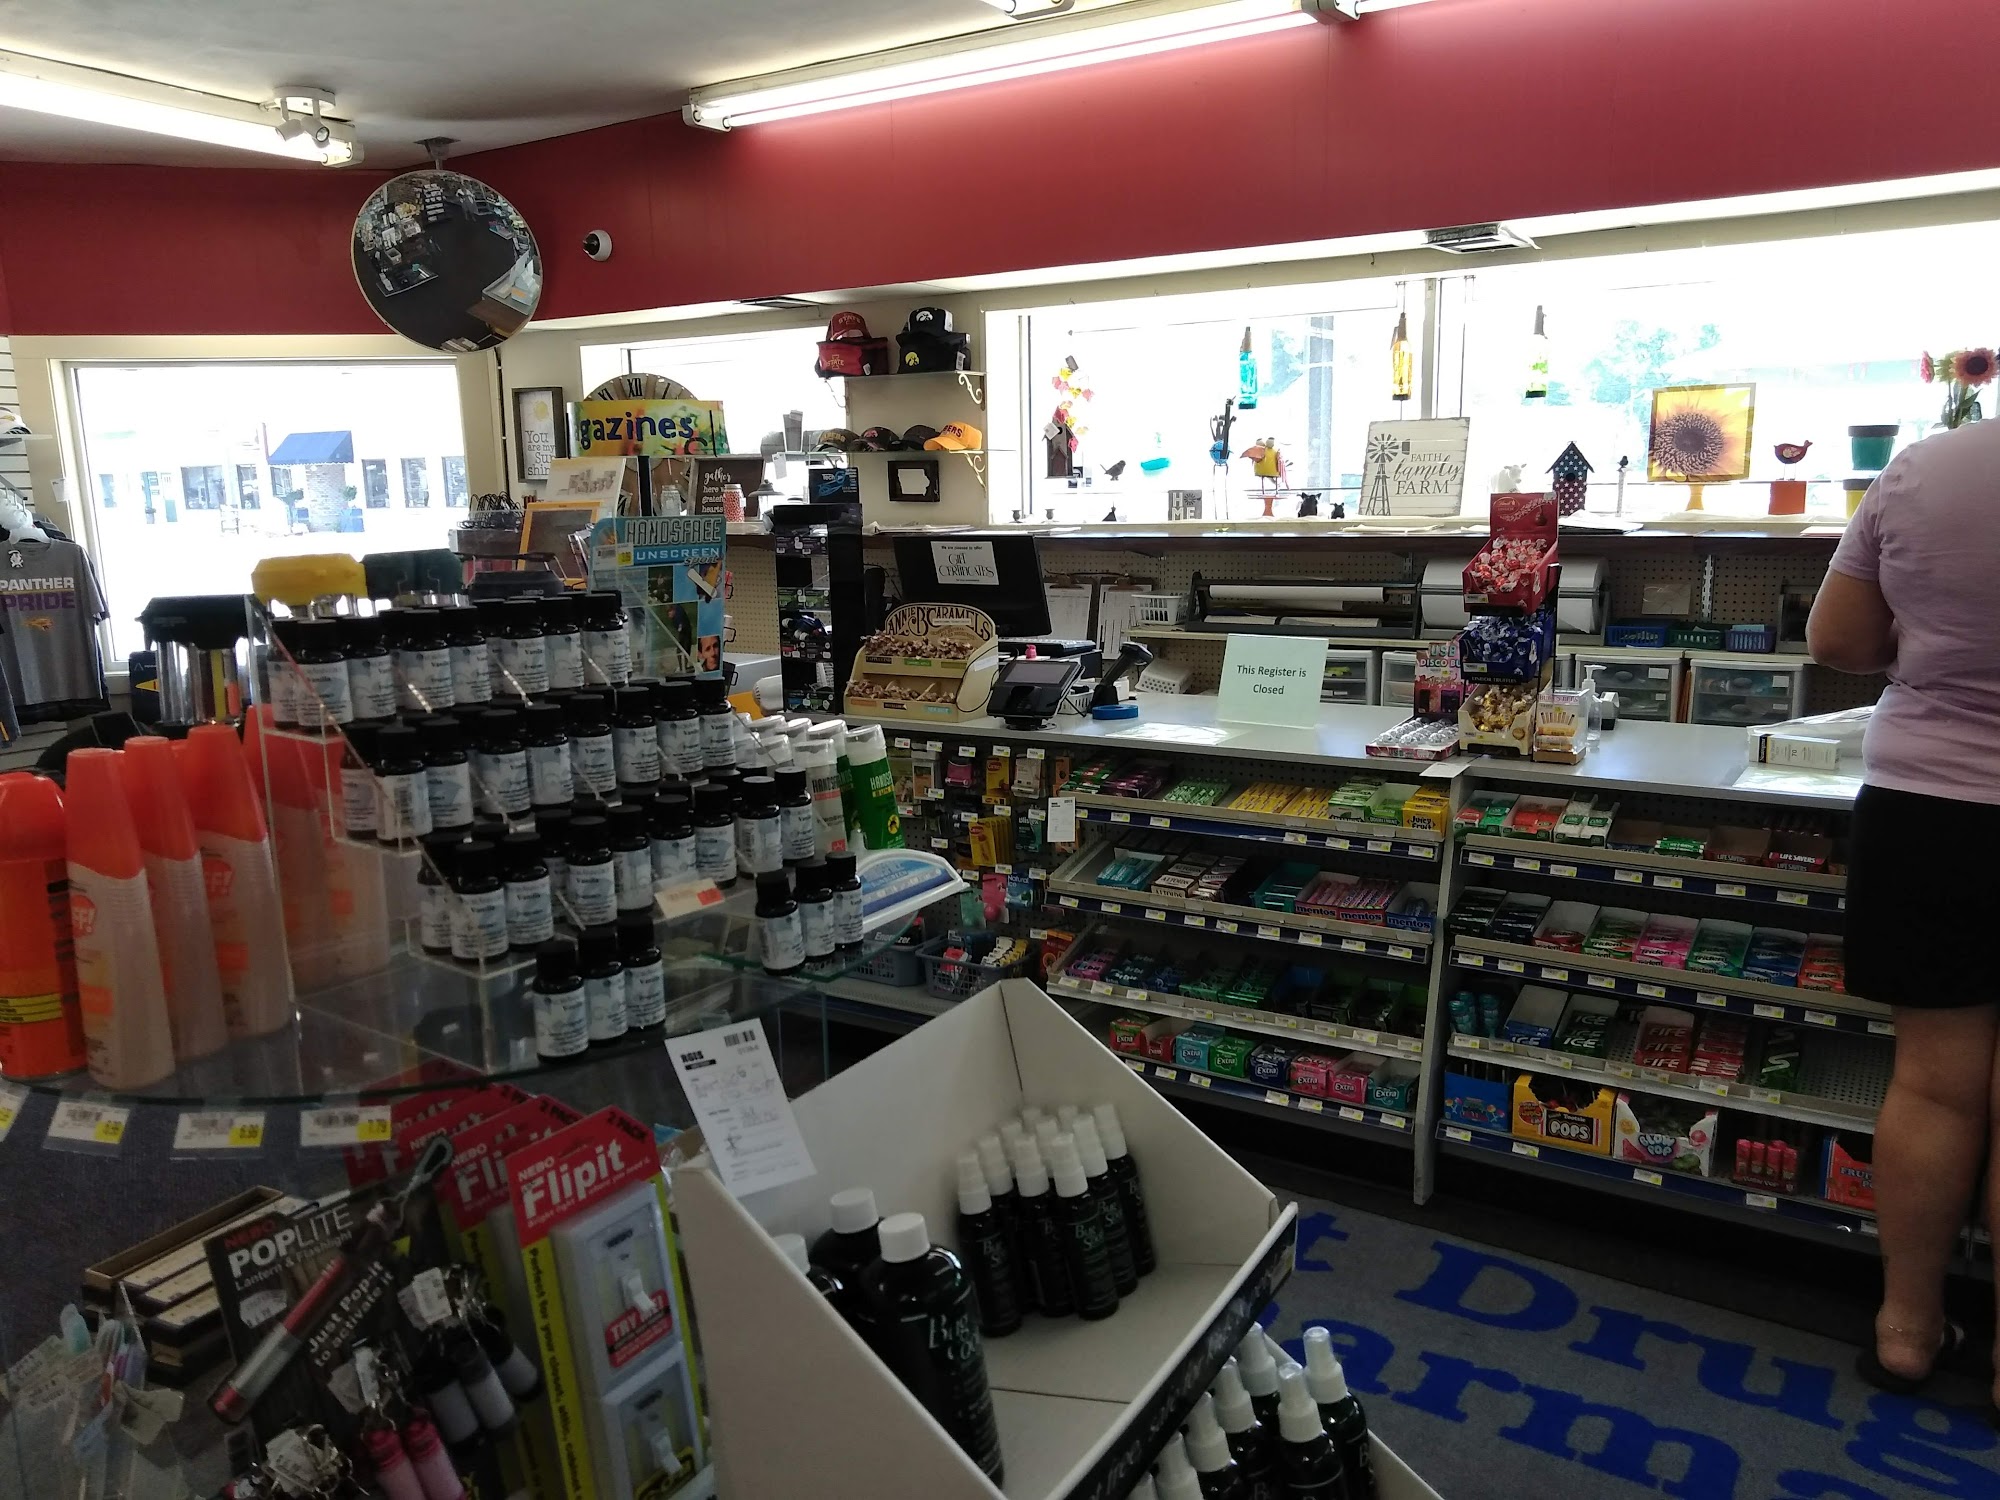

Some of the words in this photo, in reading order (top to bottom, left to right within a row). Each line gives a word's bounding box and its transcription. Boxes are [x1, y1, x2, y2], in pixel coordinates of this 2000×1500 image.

[525, 431, 549, 444] You
[541, 445, 556, 453] my
[1411, 453, 1442, 462] FAITH
[1394, 455, 1462, 481] family
[704, 467, 732, 484] gather
[1396, 480, 1450, 495] FARM
[625, 517, 722, 546] HANDSFREE
[636, 548, 719, 560] UNSCREEN
[939, 565, 994, 577] CERTIFICATES
[0, 577, 75, 591] PANTHER
[0, 592, 76, 611] PRIDE
[927, 607, 991, 641] CARAMELS
[1430, 645, 1456, 656] USB
[1237, 665, 1255, 675] This
[1258, 666, 1297, 678] Register
[1299, 668, 1307, 677] is
[1253, 684, 1285, 695] Closed
[1008, 874, 1029, 884] Natural
[1297, 905, 1336, 917] mentos
[1341, 912, 1382, 922] mentos
[1388, 916, 1431, 930] mentos
[1564, 1037, 1601, 1048] ICE
[1182, 1048, 1201, 1057] Extra
[1216, 1056, 1236, 1065] Extra
[1257, 1066, 1277, 1075] Extra
[1297, 1076, 1318, 1084] Extra
[1335, 1082, 1355, 1092] Extra
[1375, 1089, 1398, 1098] Extra
[607, 1111, 616, 1124] 2
[616, 1116, 649, 1142] PACK
[1550, 1120, 1591, 1140] POPS
[1638, 1133, 1677, 1148] BLOW
[451, 1142, 488, 1166] NEBO
[1647, 1145, 1673, 1157] POP
[517, 1155, 556, 1182] NEBO
[521, 1139, 626, 1220] Flipit
[228, 1202, 354, 1279] POPLITE
[235, 1262, 282, 1292] Lantern
[285, 1256, 295, 1269] &
[308, 1312, 342, 1354] Just
[314, 1350, 331, 1368] to
[332, 1285, 383, 1349] activate
